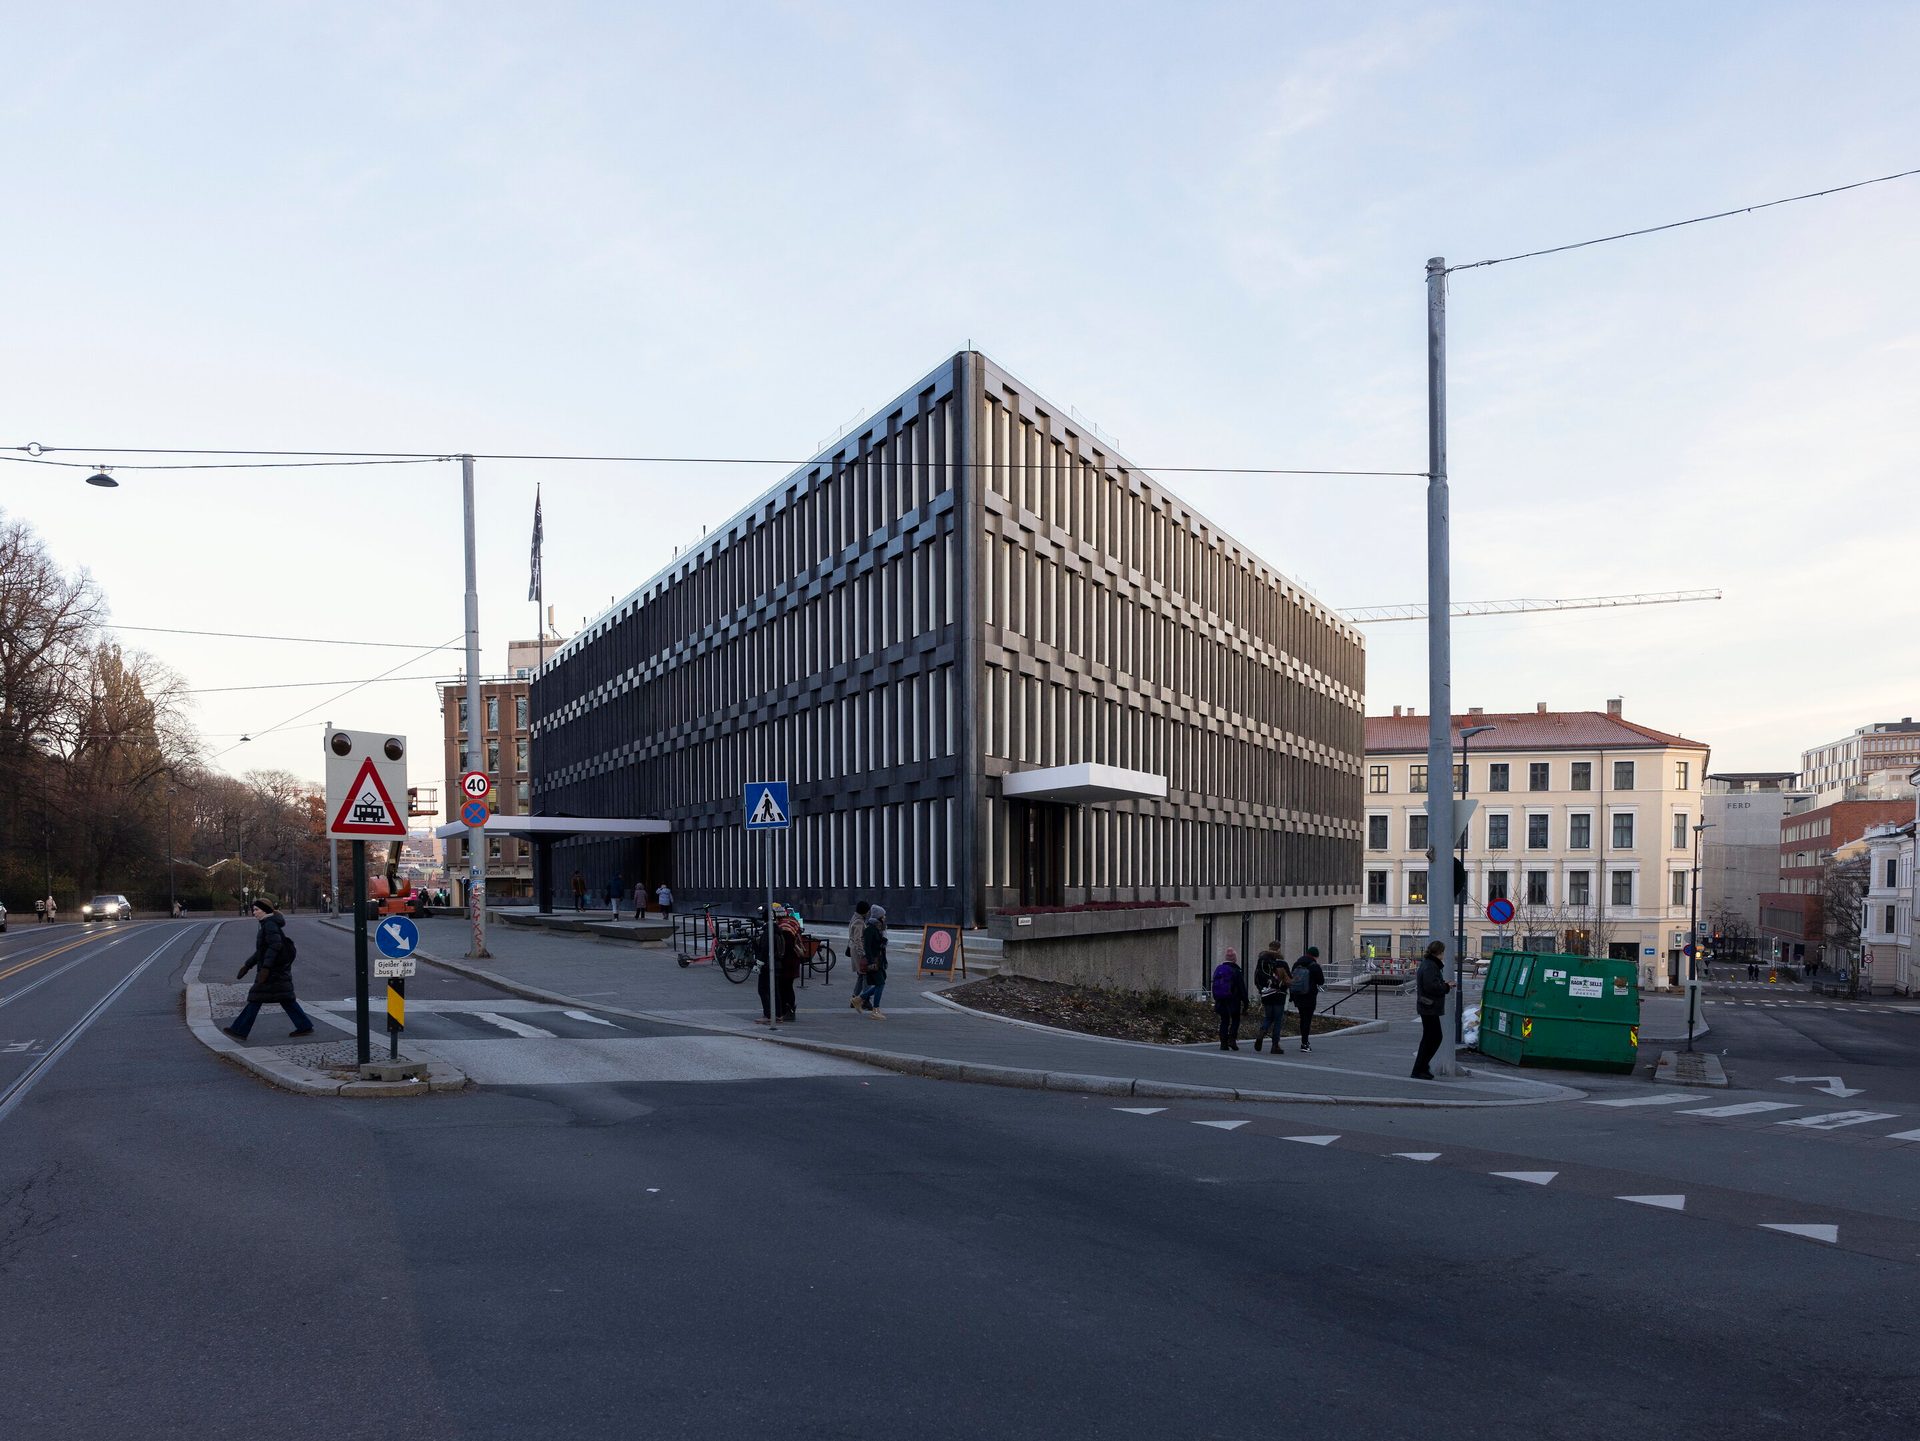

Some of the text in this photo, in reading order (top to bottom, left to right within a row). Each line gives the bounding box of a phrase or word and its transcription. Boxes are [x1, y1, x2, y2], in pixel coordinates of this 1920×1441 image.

[467, 779, 486, 791] 40
[378, 961, 399, 969] Gjelder
[926, 956, 945, 965] OPEN
